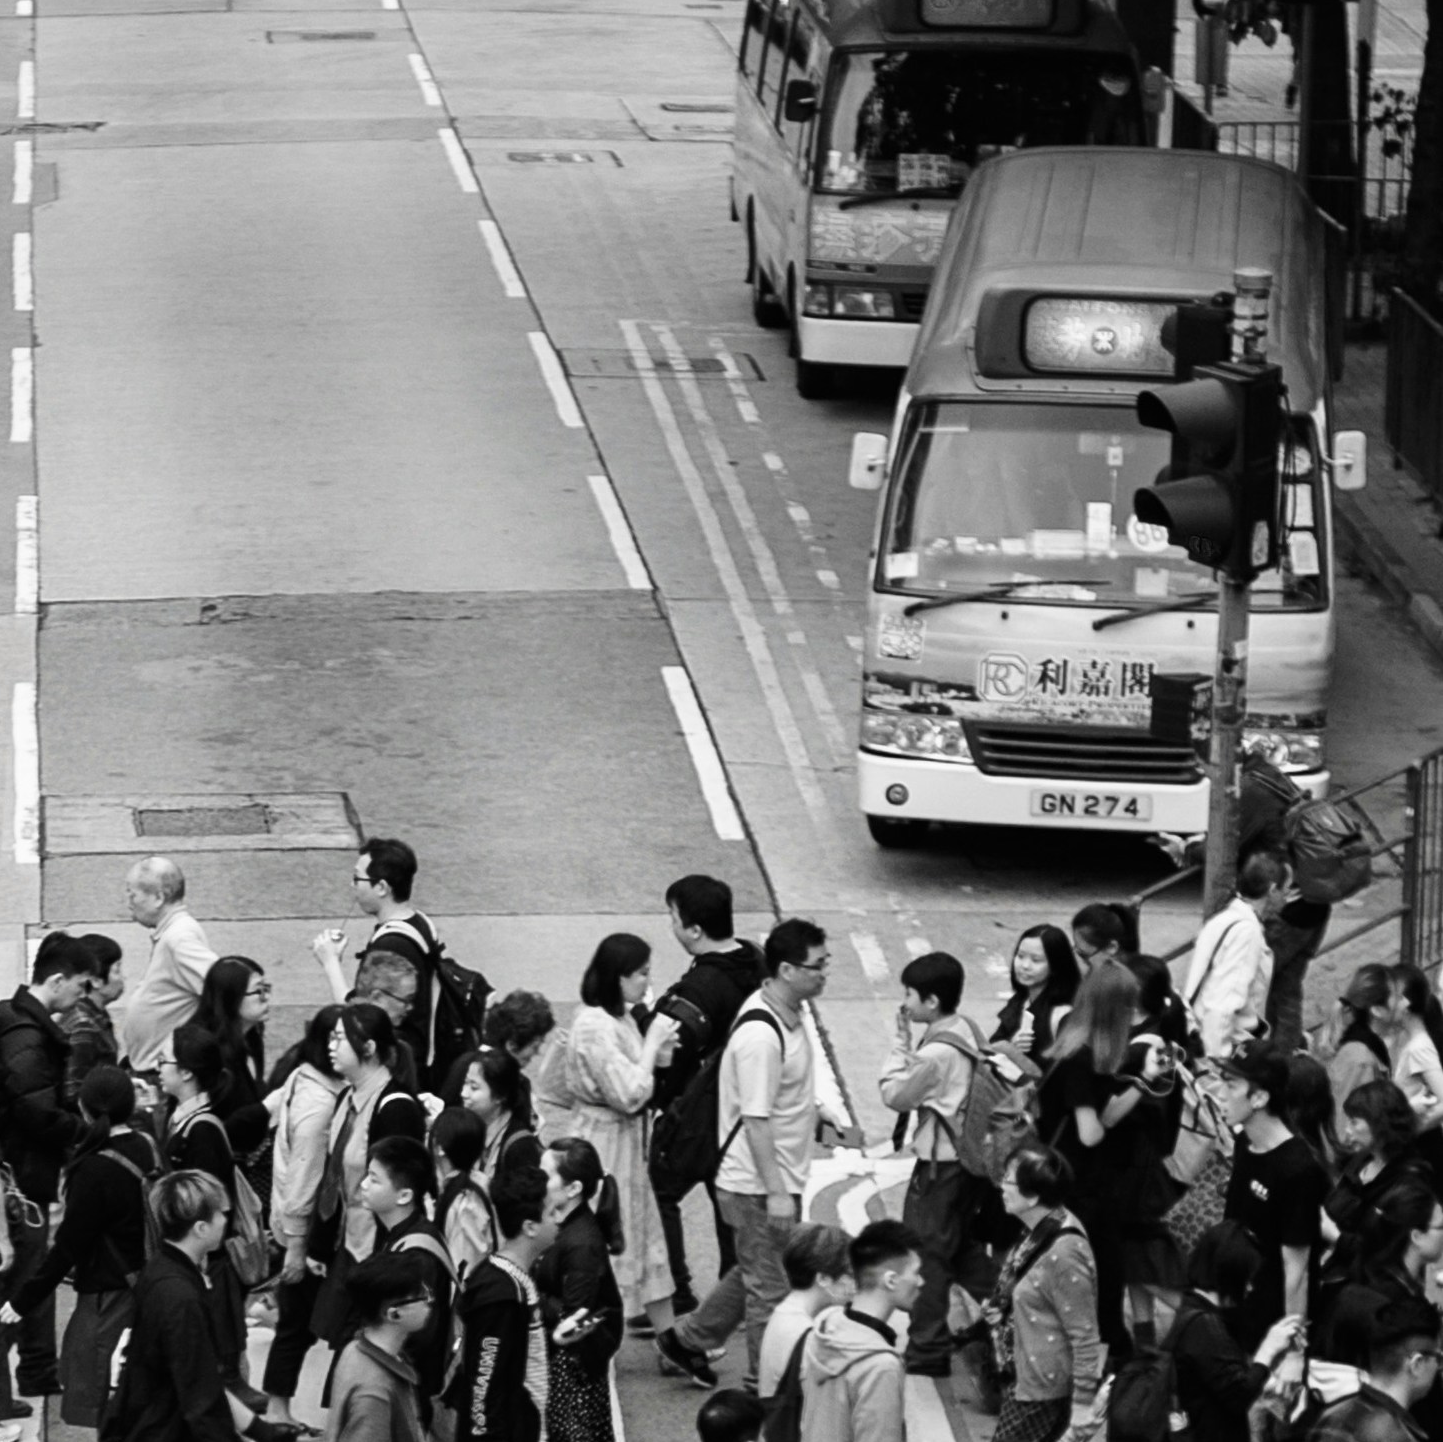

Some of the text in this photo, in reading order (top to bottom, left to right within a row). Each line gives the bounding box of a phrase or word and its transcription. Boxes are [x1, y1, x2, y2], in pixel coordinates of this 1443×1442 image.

[1035, 659, 1155, 698] 利嘉閣
[1040, 793, 1139, 817] GN 274
